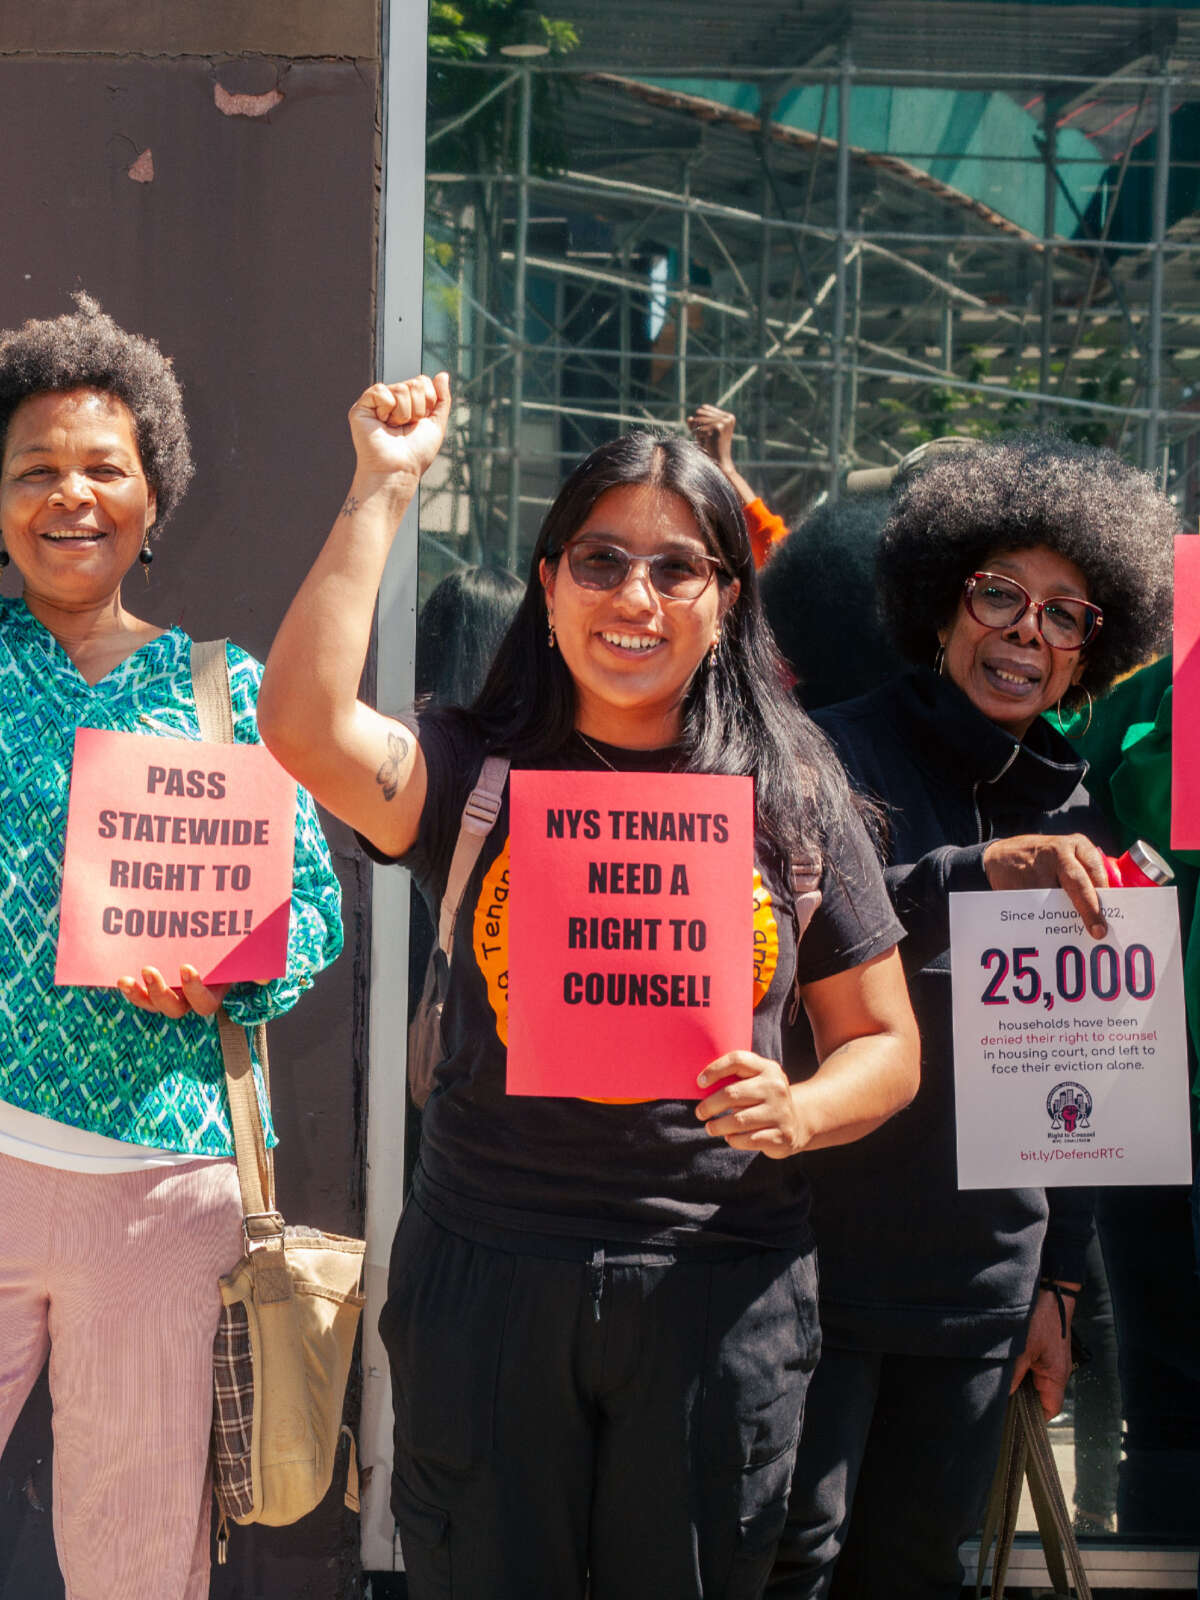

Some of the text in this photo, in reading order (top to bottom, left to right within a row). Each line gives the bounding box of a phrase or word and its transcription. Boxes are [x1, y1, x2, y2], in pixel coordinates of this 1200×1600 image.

[146, 765, 227, 800] PASS
[98, 810, 270, 846] STATEWIDE
[546, 809, 729, 843] NYS TENANTS
[109, 859, 252, 892] RIGHT TO
[588, 862, 690, 896] NEED A
[102, 906, 254, 939] COUNSEL!
[1000, 910, 1034, 921] Since
[1045, 923, 1084, 935] nearly
[568, 917, 707, 952] RIGHT TO
[563, 972, 711, 1008] COUNSEL!
[980, 944, 1155, 1011] 25,000
[980, 1030, 1157, 1045] denied their right to counsel
[998, 1016, 1138, 1030] households have been
[984, 1045, 1155, 1060] in housing court, and left to
[991, 1060, 1144, 1074] face their eviction alone.
[1020, 1148, 1124, 1162] bit.ly/DefendRTC
